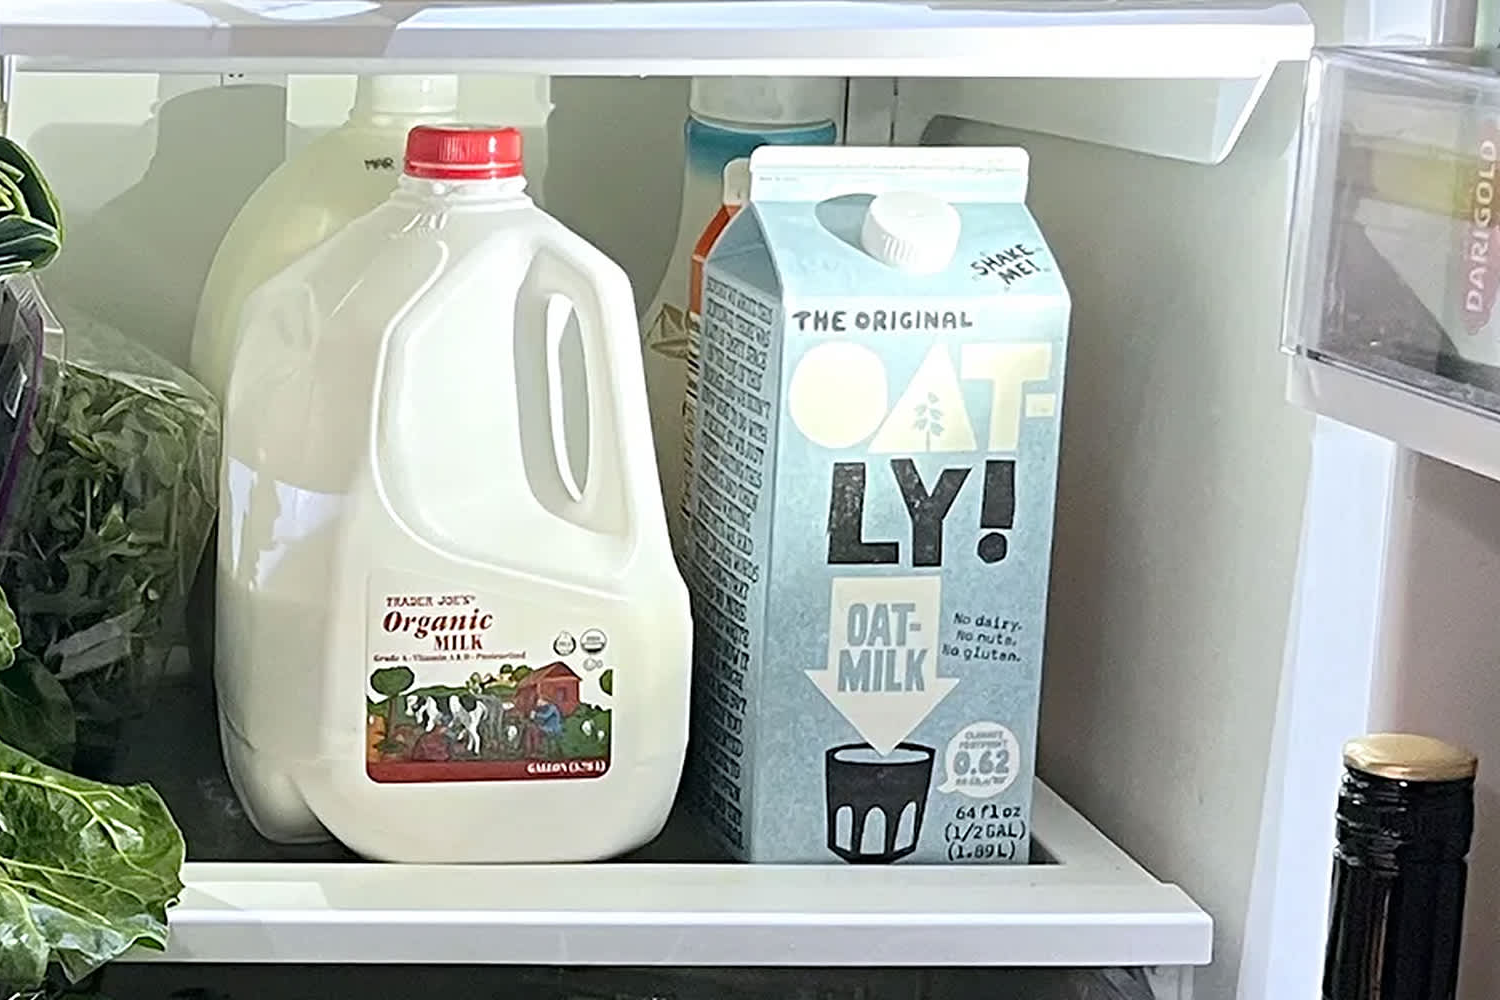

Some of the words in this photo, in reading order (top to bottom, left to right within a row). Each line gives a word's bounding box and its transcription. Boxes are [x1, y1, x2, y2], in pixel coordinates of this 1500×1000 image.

[1465, 139, 1498, 313] DARIGOLD
[971, 244, 1034, 275] SHAKE
[998, 259, 1041, 285] ME!
[793, 311, 847, 331] THE
[855, 310, 973, 331] ORIGINAL
[827, 458, 1017, 566] LY!
[383, 608, 493, 639] Organic
[847, 603, 922, 647] OAT-
[953, 612, 971, 625] No
[975, 615, 1022, 633] dairy.
[435, 634, 483, 651] MILK
[956, 630, 974, 642] No
[942, 644, 960, 657] No
[964, 646, 1022, 662] gluten.
[837, 649, 928, 692] MILK
[953, 750, 1010, 776] 0.62
[956, 806, 976, 819] 64
